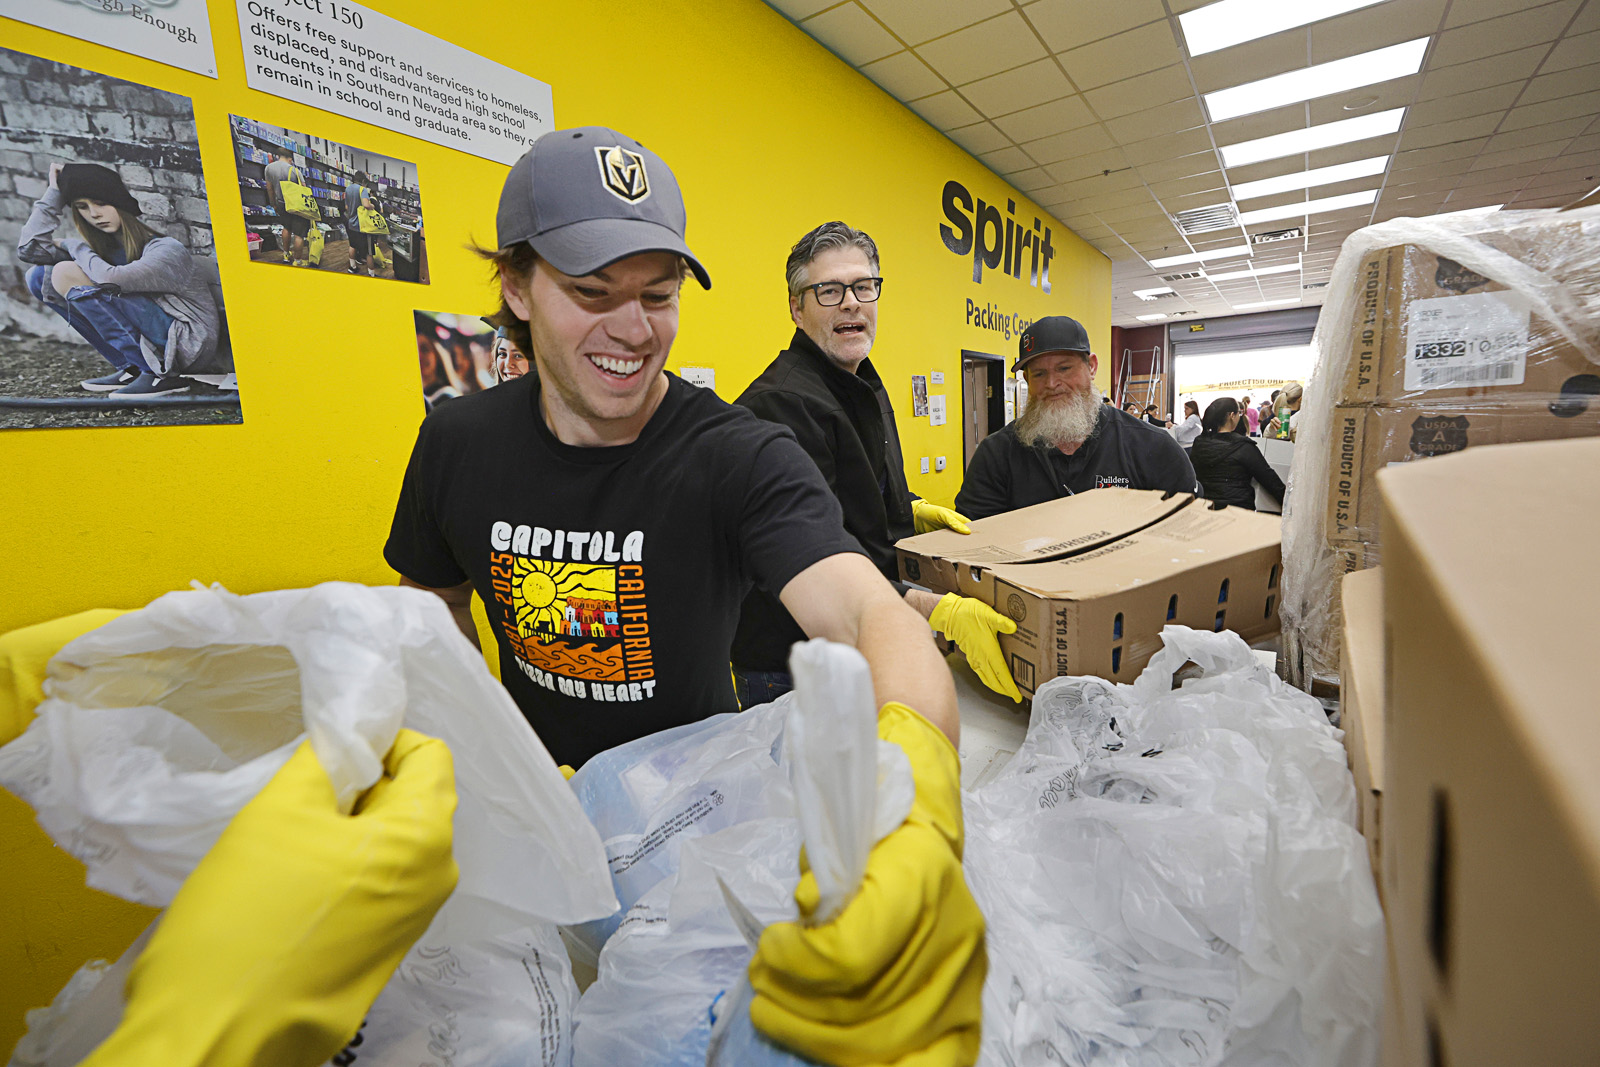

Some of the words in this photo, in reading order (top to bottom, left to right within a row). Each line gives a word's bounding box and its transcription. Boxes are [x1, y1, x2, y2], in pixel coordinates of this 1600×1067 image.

[98, 0, 124, 12] gh
[131, 4, 198, 44] Enough
[330, 2, 364, 30] 150
[248, 1, 301, 32] Offers
[305, 23, 336, 45] free
[340, 39, 396, 67] support
[399, 61, 423, 77] and
[426, 71, 474, 97] services
[477, 89, 489, 102] to
[491, 93, 542, 123] homeless,
[251, 22, 335, 64] displaced,
[339, 56, 366, 73] and
[370, 66, 462, 107] disadvantaged
[465, 98, 489, 117] high
[492, 112, 525, 129] school
[253, 44, 325, 76] students
[328, 66, 342, 82] in
[346, 73, 409, 104] Southern
[412, 95, 459, 121] Nevada
[462, 116, 486, 131] area
[489, 124, 501, 135] so
[503, 128, 526, 146] they
[257, 64, 314, 91] remain
[317, 80, 332, 97] in
[336, 92, 382, 111] school
[386, 106, 410, 121] and
[414, 115, 472, 141] graduate.
[940, 180, 1053, 295] spirit
[1363, 260, 1379, 325] PRODUCT
[966, 298, 1010, 341] Packing
[1362, 329, 1374, 347] OF
[1424, 421, 1458, 430] USDA
[1432, 430, 1446, 442] A
[1341, 418, 1356, 477] PRODUCT
[1095, 475, 1130, 489] Builders
[1339, 481, 1352, 497] OF
[1336, 501, 1349, 534] U.S.A.
[491, 521, 644, 562] CAPITOLA
[490, 552, 513, 605] 2025
[618, 564, 655, 681] CALIFORNIA
[1056, 607, 1067, 635] U.S.A.
[1056, 638, 1068, 650] OF
[558, 676, 587, 699] MY
[591, 680, 656, 702] HEART
